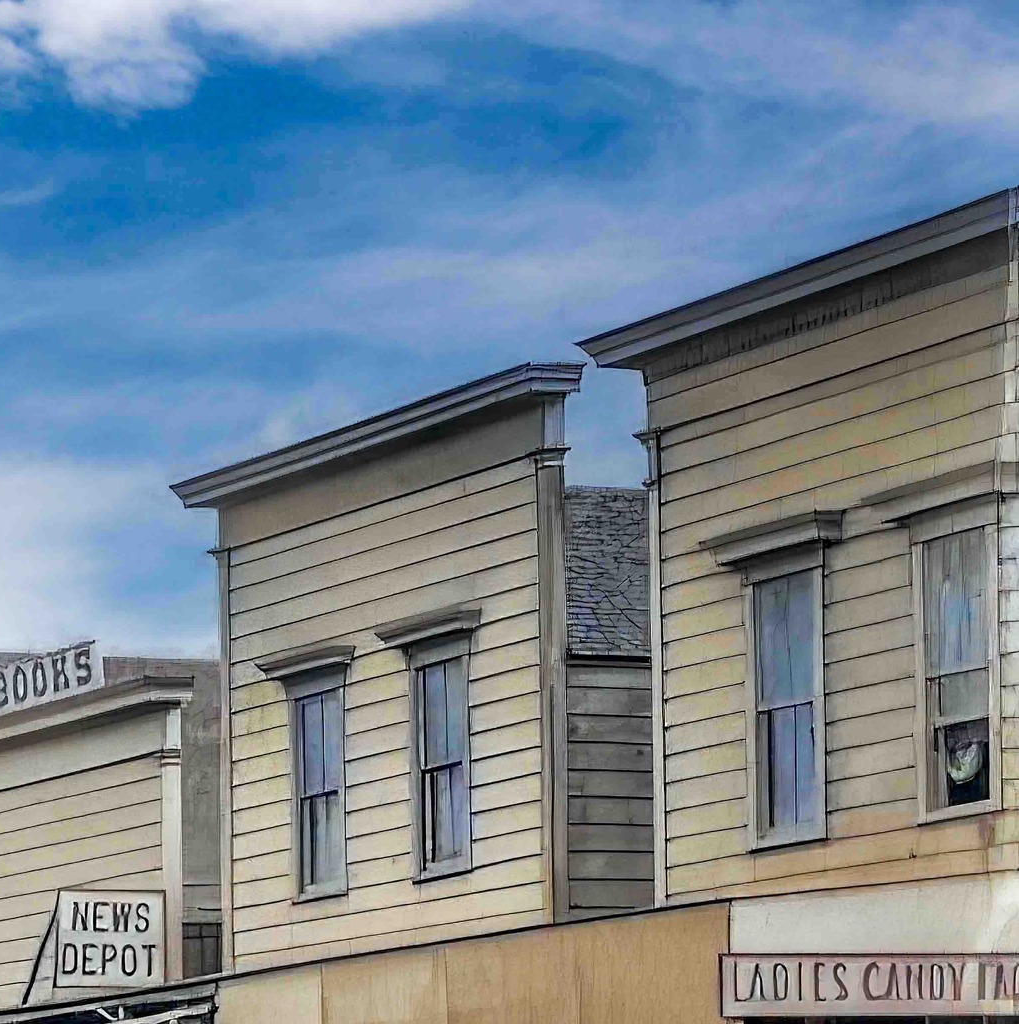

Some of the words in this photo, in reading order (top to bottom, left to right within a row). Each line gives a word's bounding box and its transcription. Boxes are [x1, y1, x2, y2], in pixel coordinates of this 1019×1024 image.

[70, 901, 151, 933] NEWS
[61, 943, 157, 978] DEPOT
[733, 961, 849, 1002] LADIES
[862, 961, 966, 1001] CANDY
